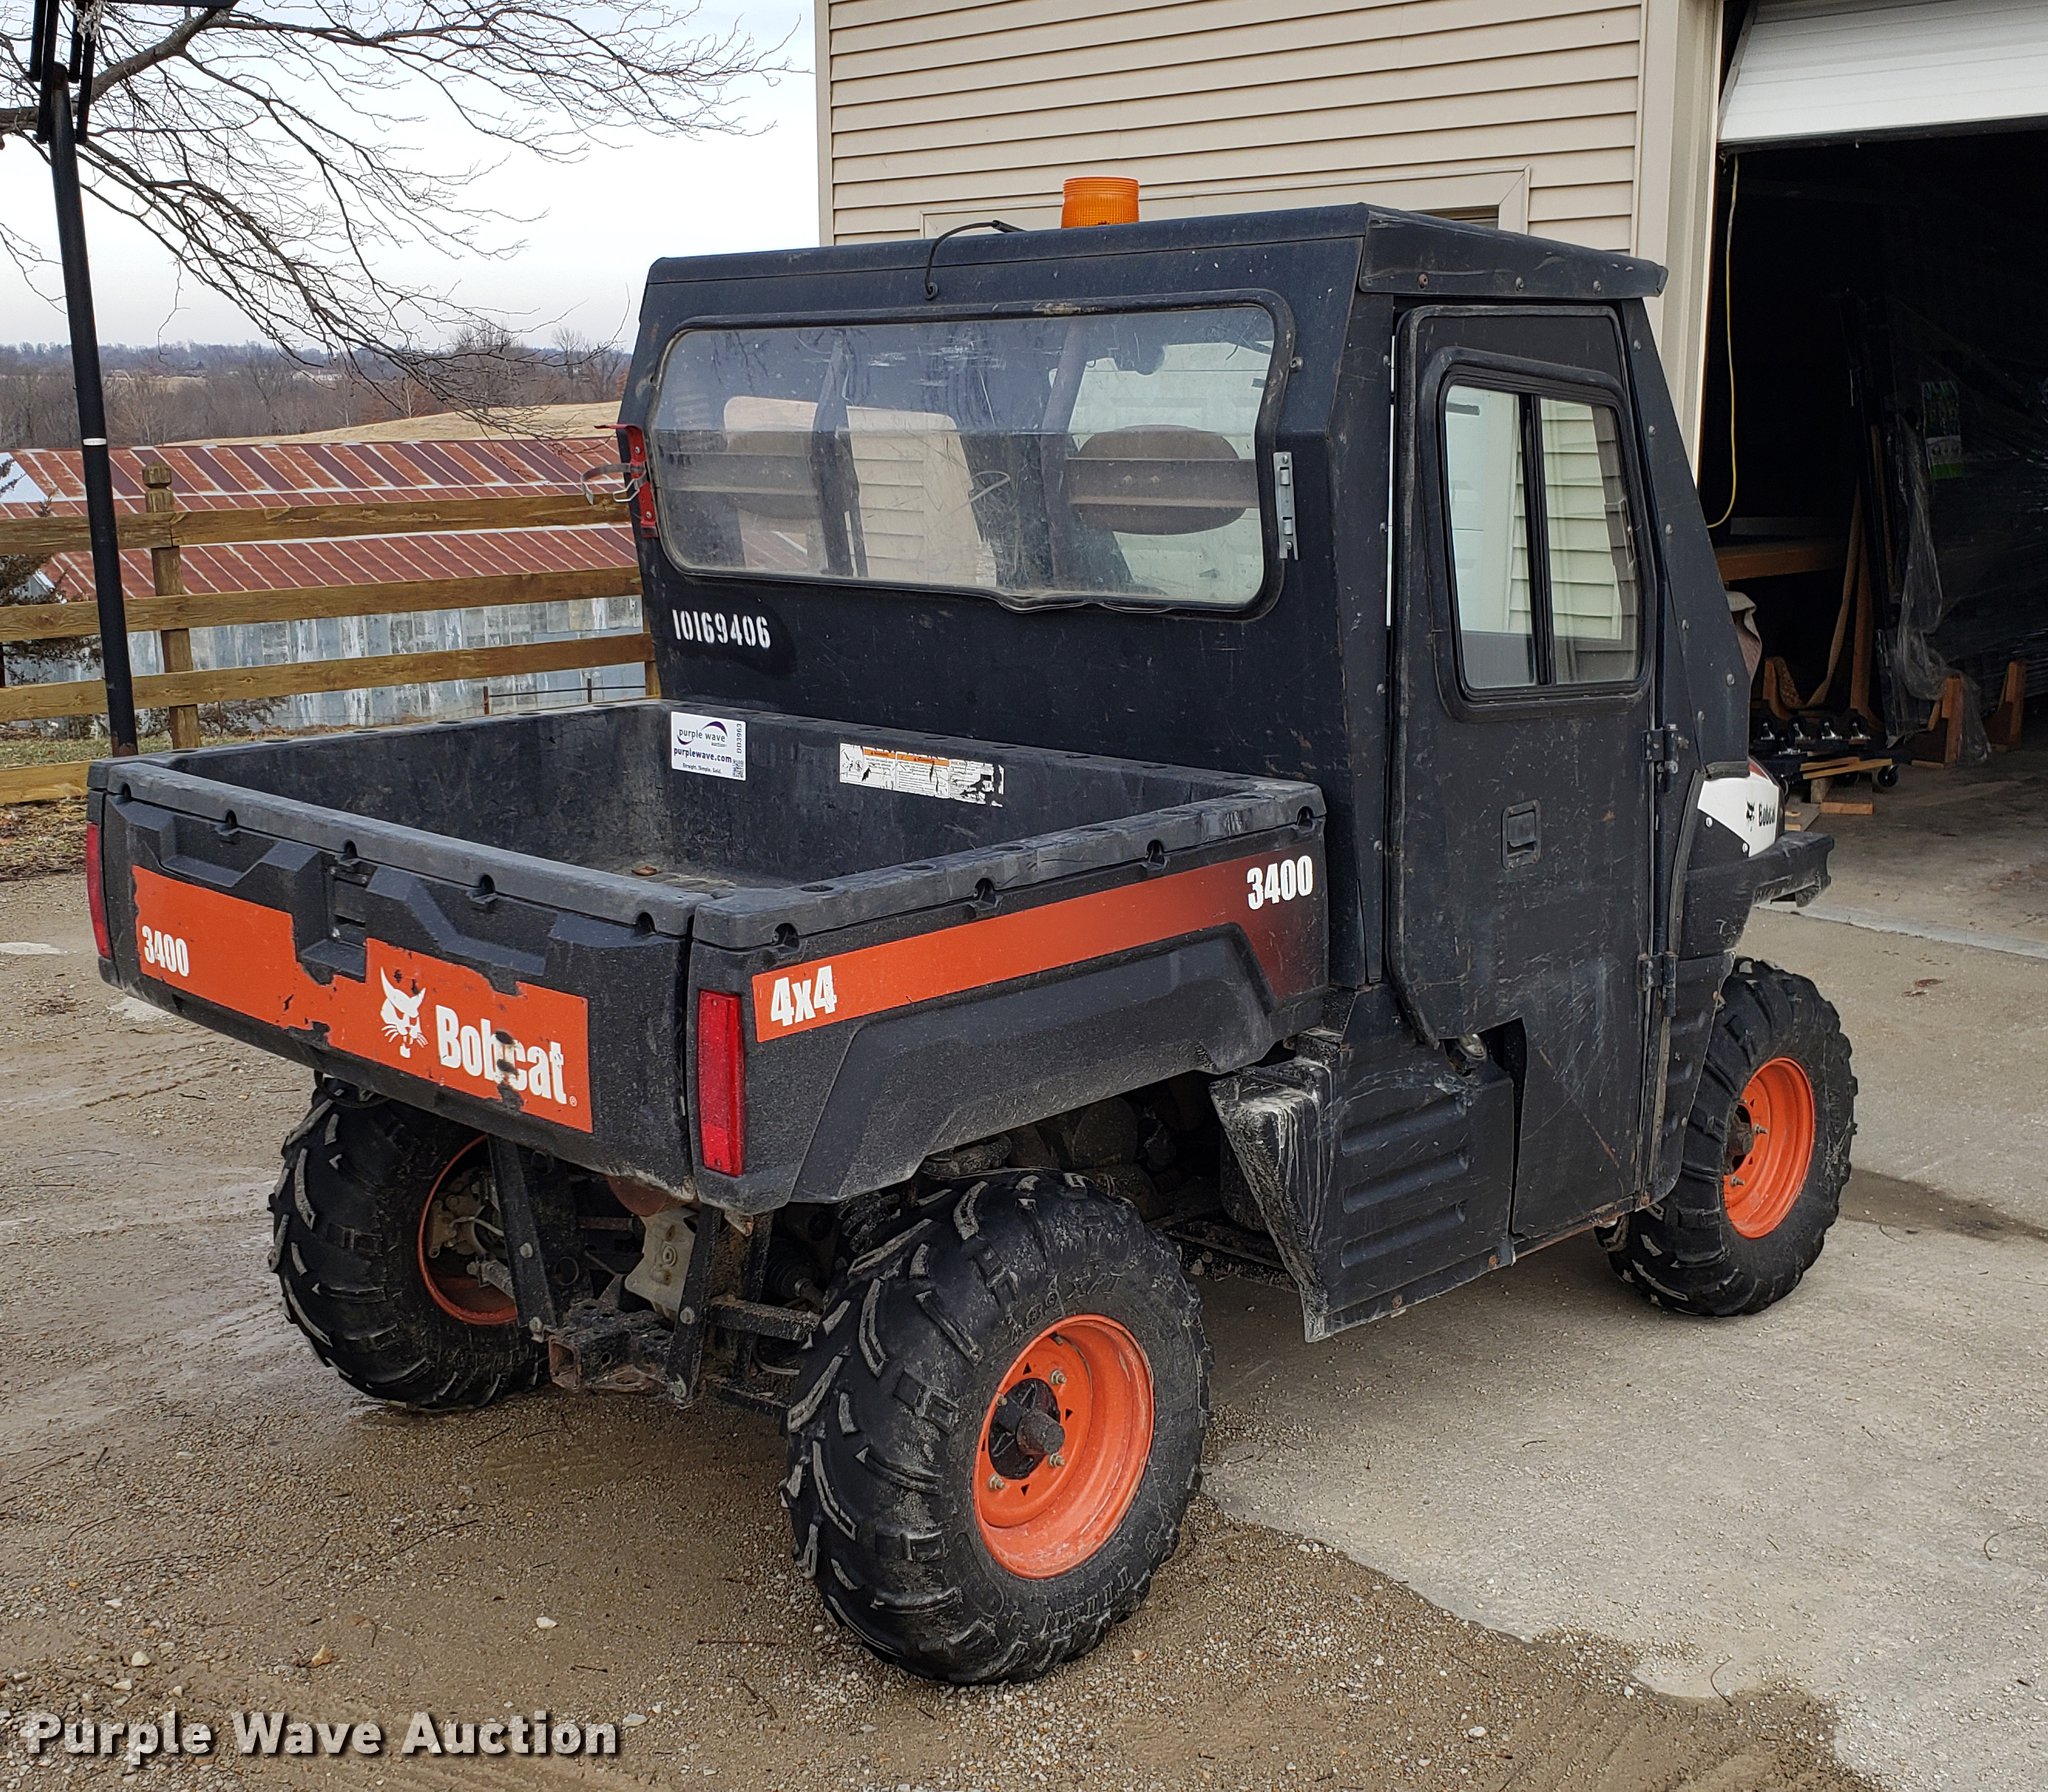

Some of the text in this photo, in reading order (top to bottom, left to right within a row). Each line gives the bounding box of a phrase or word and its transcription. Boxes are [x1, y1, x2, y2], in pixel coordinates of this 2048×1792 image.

[672, 609, 771, 649] 10169406
[673, 747, 732, 763] purplewave.com
[679, 729, 726, 743] purple wave
[1247, 856, 1313, 910] 3400
[141, 924, 189, 977] 3400
[769, 965, 837, 1026] 4x4
[435, 1004, 567, 1105] Bobcat
